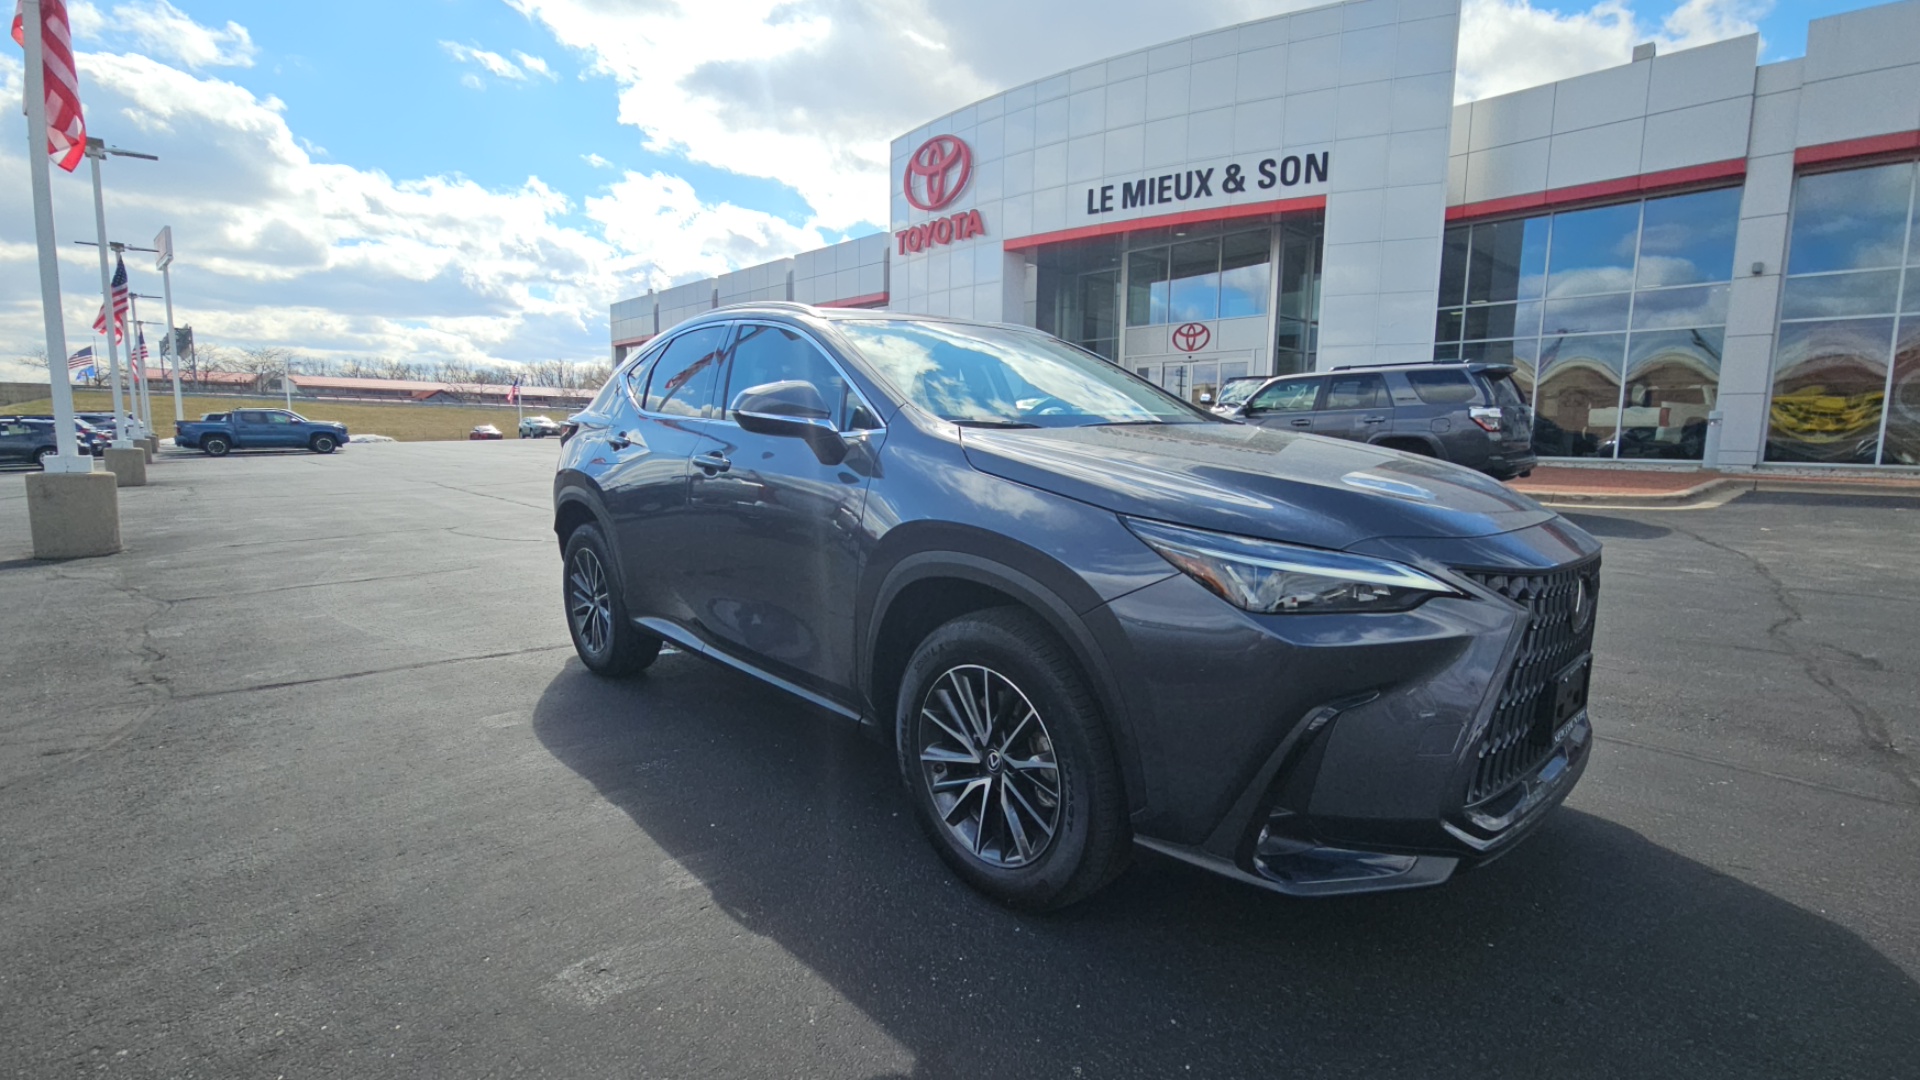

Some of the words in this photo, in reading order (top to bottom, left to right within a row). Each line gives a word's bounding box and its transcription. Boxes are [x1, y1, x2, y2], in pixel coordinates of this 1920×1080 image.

[1087, 184, 1114, 215] LE
[1121, 167, 1215, 209] MIEUX
[1222, 163, 1246, 194] &
[1257, 151, 1329, 190] SON
[895, 208, 986, 255] TOYOTA
